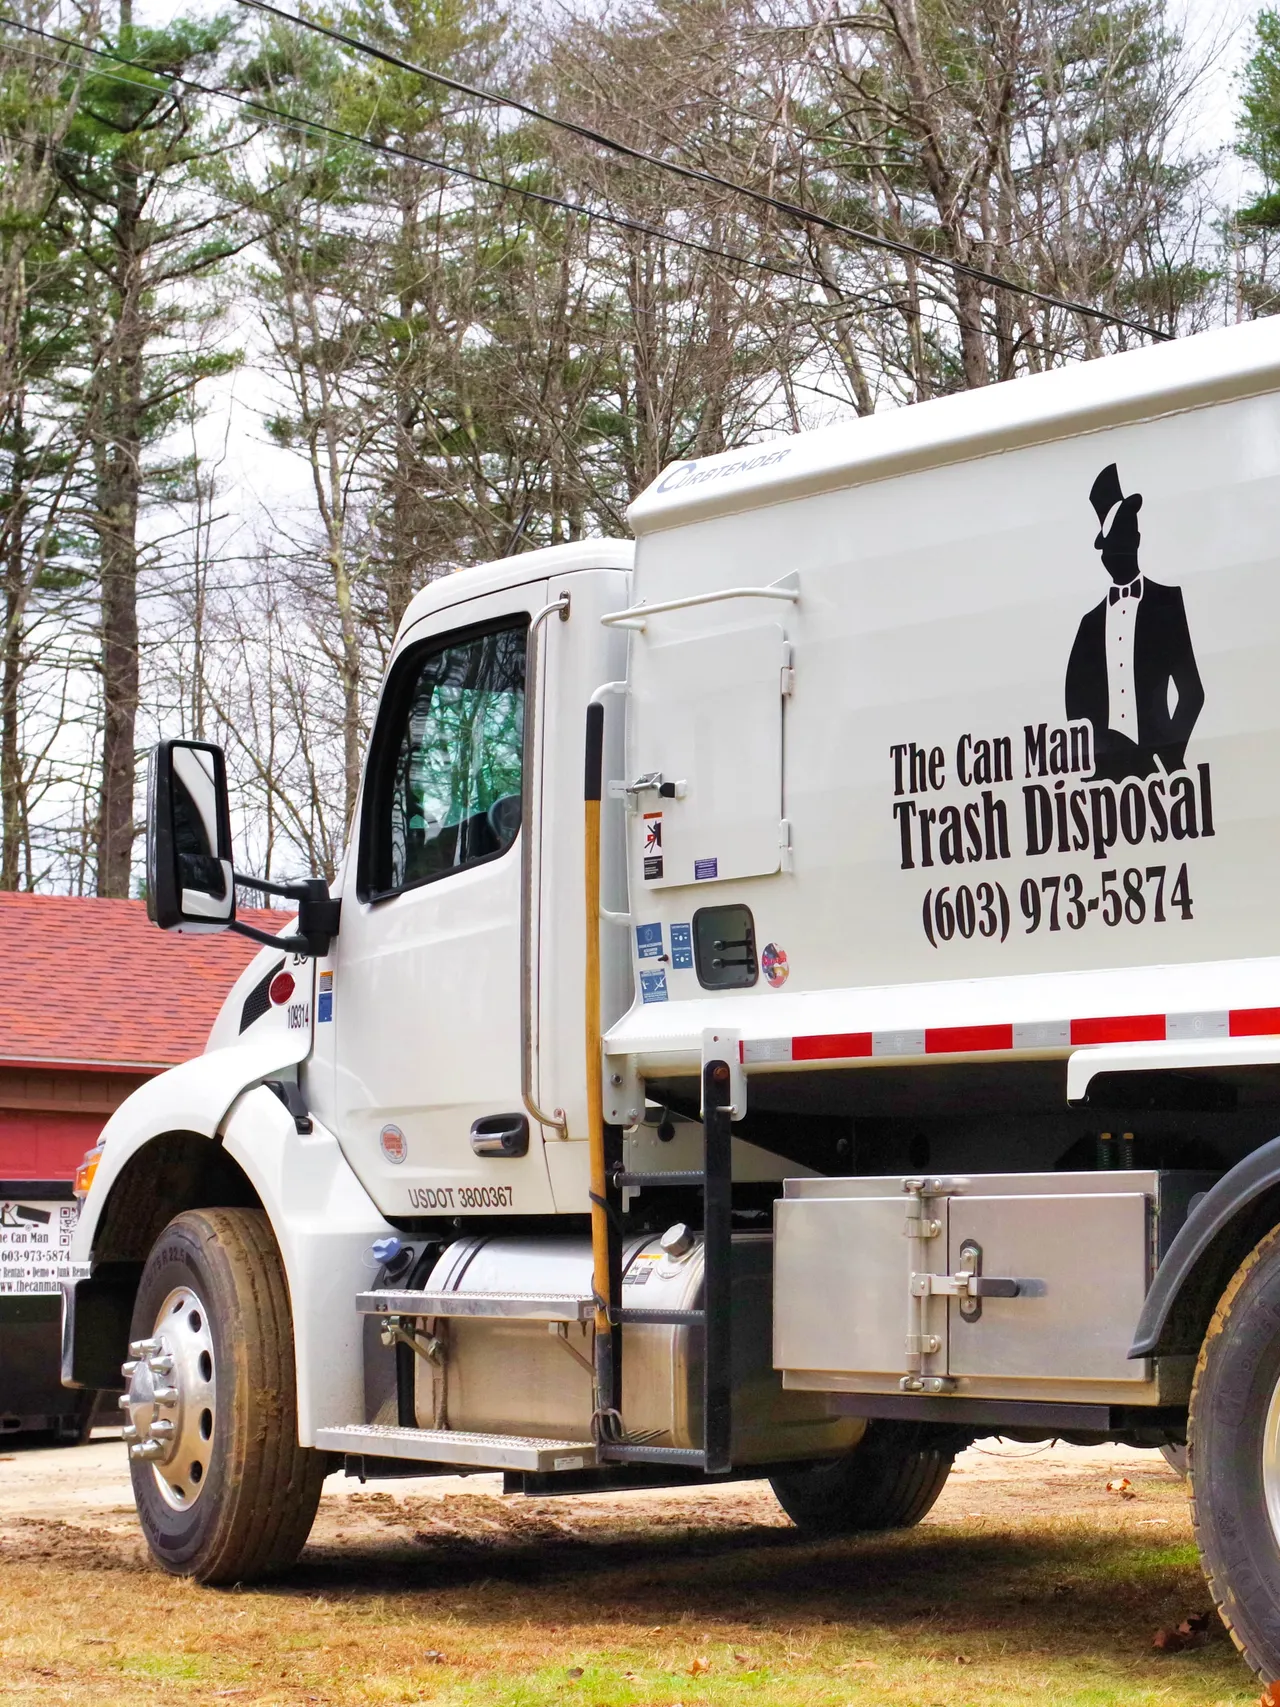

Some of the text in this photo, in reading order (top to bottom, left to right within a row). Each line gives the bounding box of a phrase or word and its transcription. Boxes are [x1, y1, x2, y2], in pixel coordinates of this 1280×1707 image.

[890, 723, 1091, 797] The Can Man
[893, 762, 1216, 870] Trash Disposal
[922, 863, 1194, 949] (603) 973-5874
[408, 1186, 513, 1209] USDOT 3800367
[11, 1232, 27, 1243] Can
[30, 1232, 49, 1243] Man
